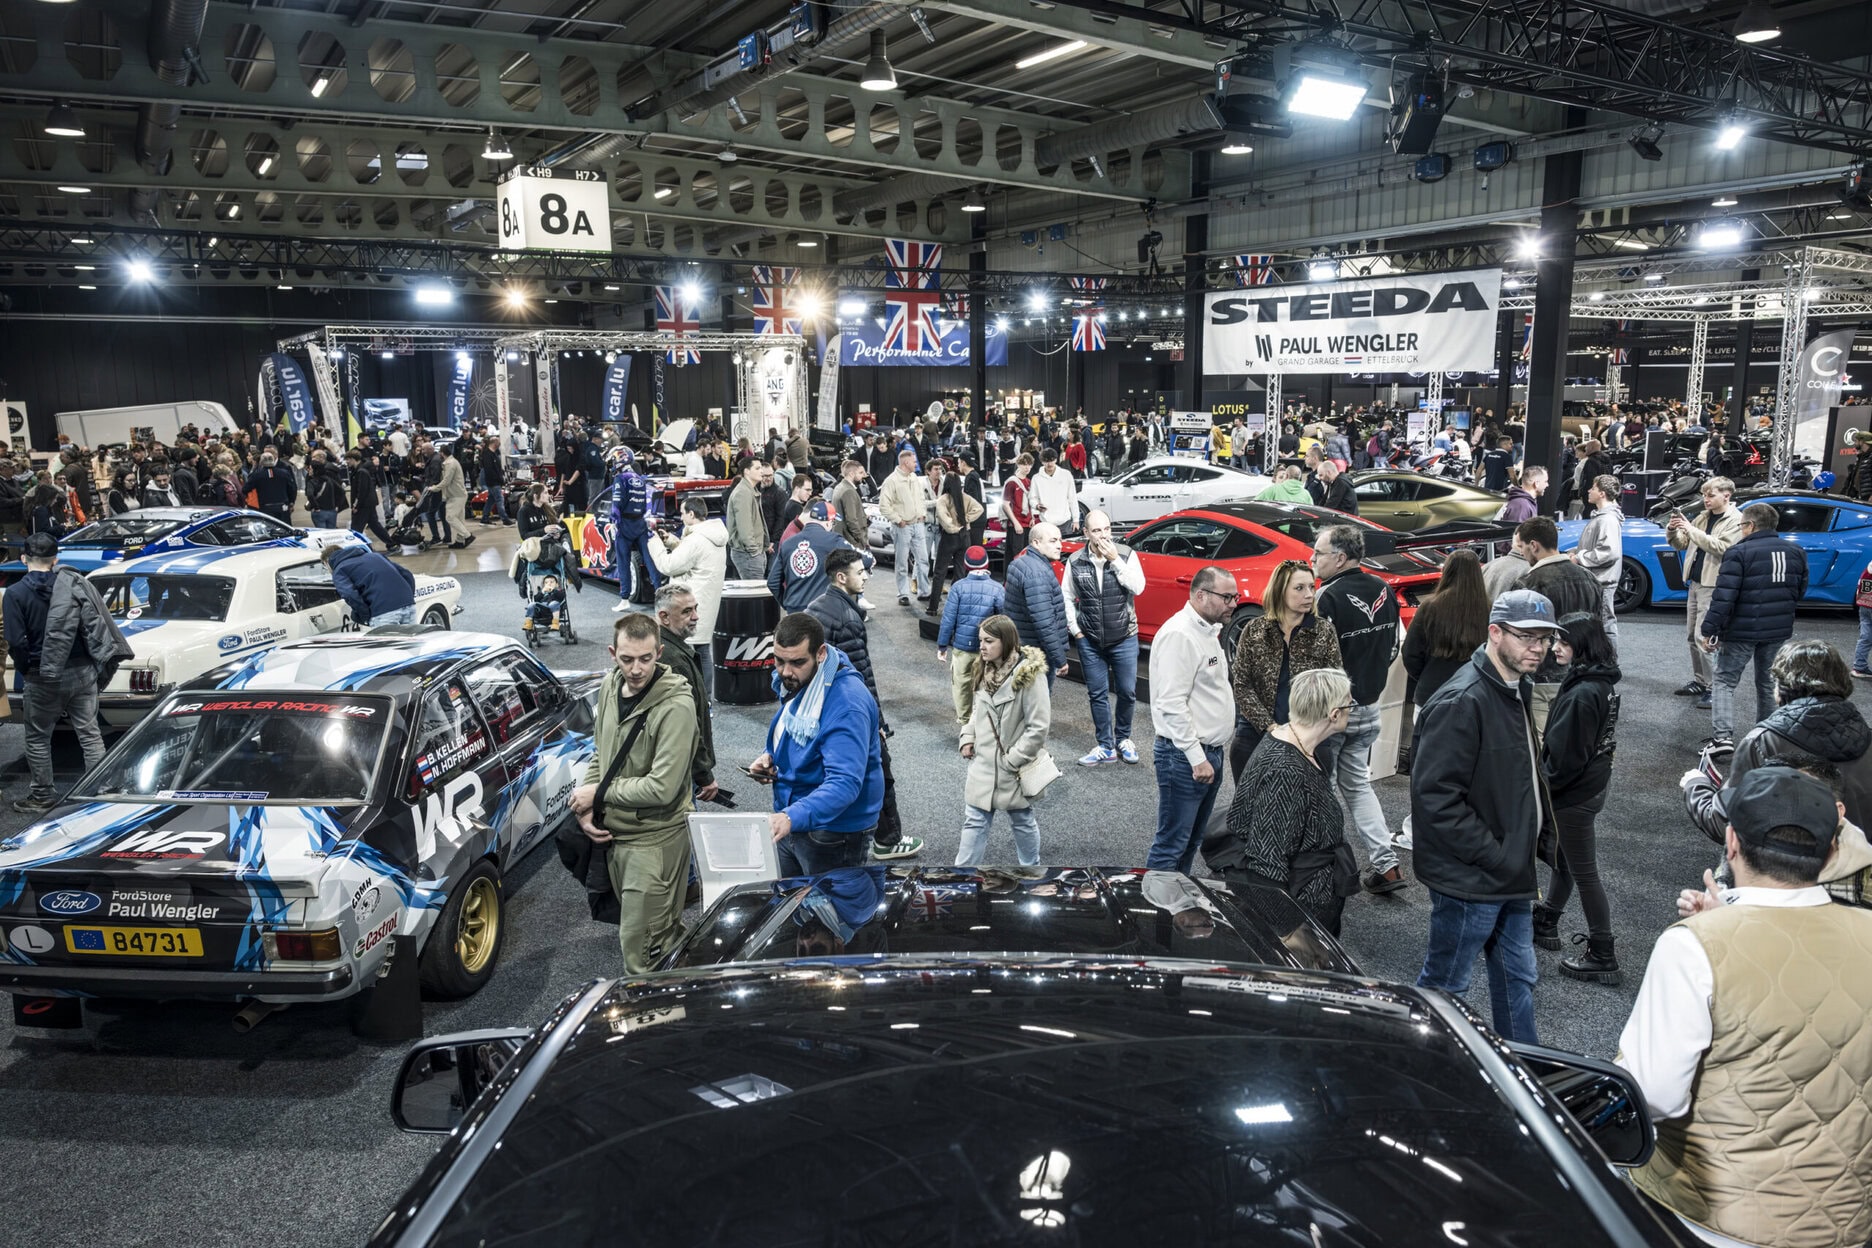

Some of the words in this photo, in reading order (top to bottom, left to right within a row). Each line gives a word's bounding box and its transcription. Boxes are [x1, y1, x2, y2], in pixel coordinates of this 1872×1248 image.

[536, 167, 552, 178] H9
[575, 170, 590, 180] H7
[502, 197, 520, 238] 8A
[539, 192, 595, 236] 8A
[1211, 281, 1490, 325] STEEDA
[850, 338, 943, 364] Performance
[948, 340, 971, 358] Ca
[1279, 336, 1323, 354] PAUL
[1327, 332, 1419, 353] WENGLER
[1245, 359, 1254, 367] by
[1277, 356, 1306, 367] GRAND
[1307, 356, 1340, 366] GARAGE
[1367, 355, 1419, 365] ETTELBRUCK
[1211, 404, 1245, 416] LOTUS
[124, 536, 144, 546] FORD
[414, 586, 435, 599] ENGLER
[246, 626, 271, 637] FordStore
[248, 634, 263, 644] PAUL
[263, 628, 287, 641] WENGLER
[1340, 622, 1396, 639] CORVETTE
[201, 700, 279, 712] WENGLER
[283, 701, 340, 714] RACING
[436, 733, 469, 759] KELLEN
[442, 736, 487, 772] HOFFMANN
[107, 830, 227, 854] WR
[111, 890, 172, 902] FordStore
[108, 902, 146, 918] Paul
[150, 903, 220, 922] Wengler
[24, 928, 43, 949] L
[366, 911, 398, 952] Castrol
[112, 931, 189, 953] 84731
